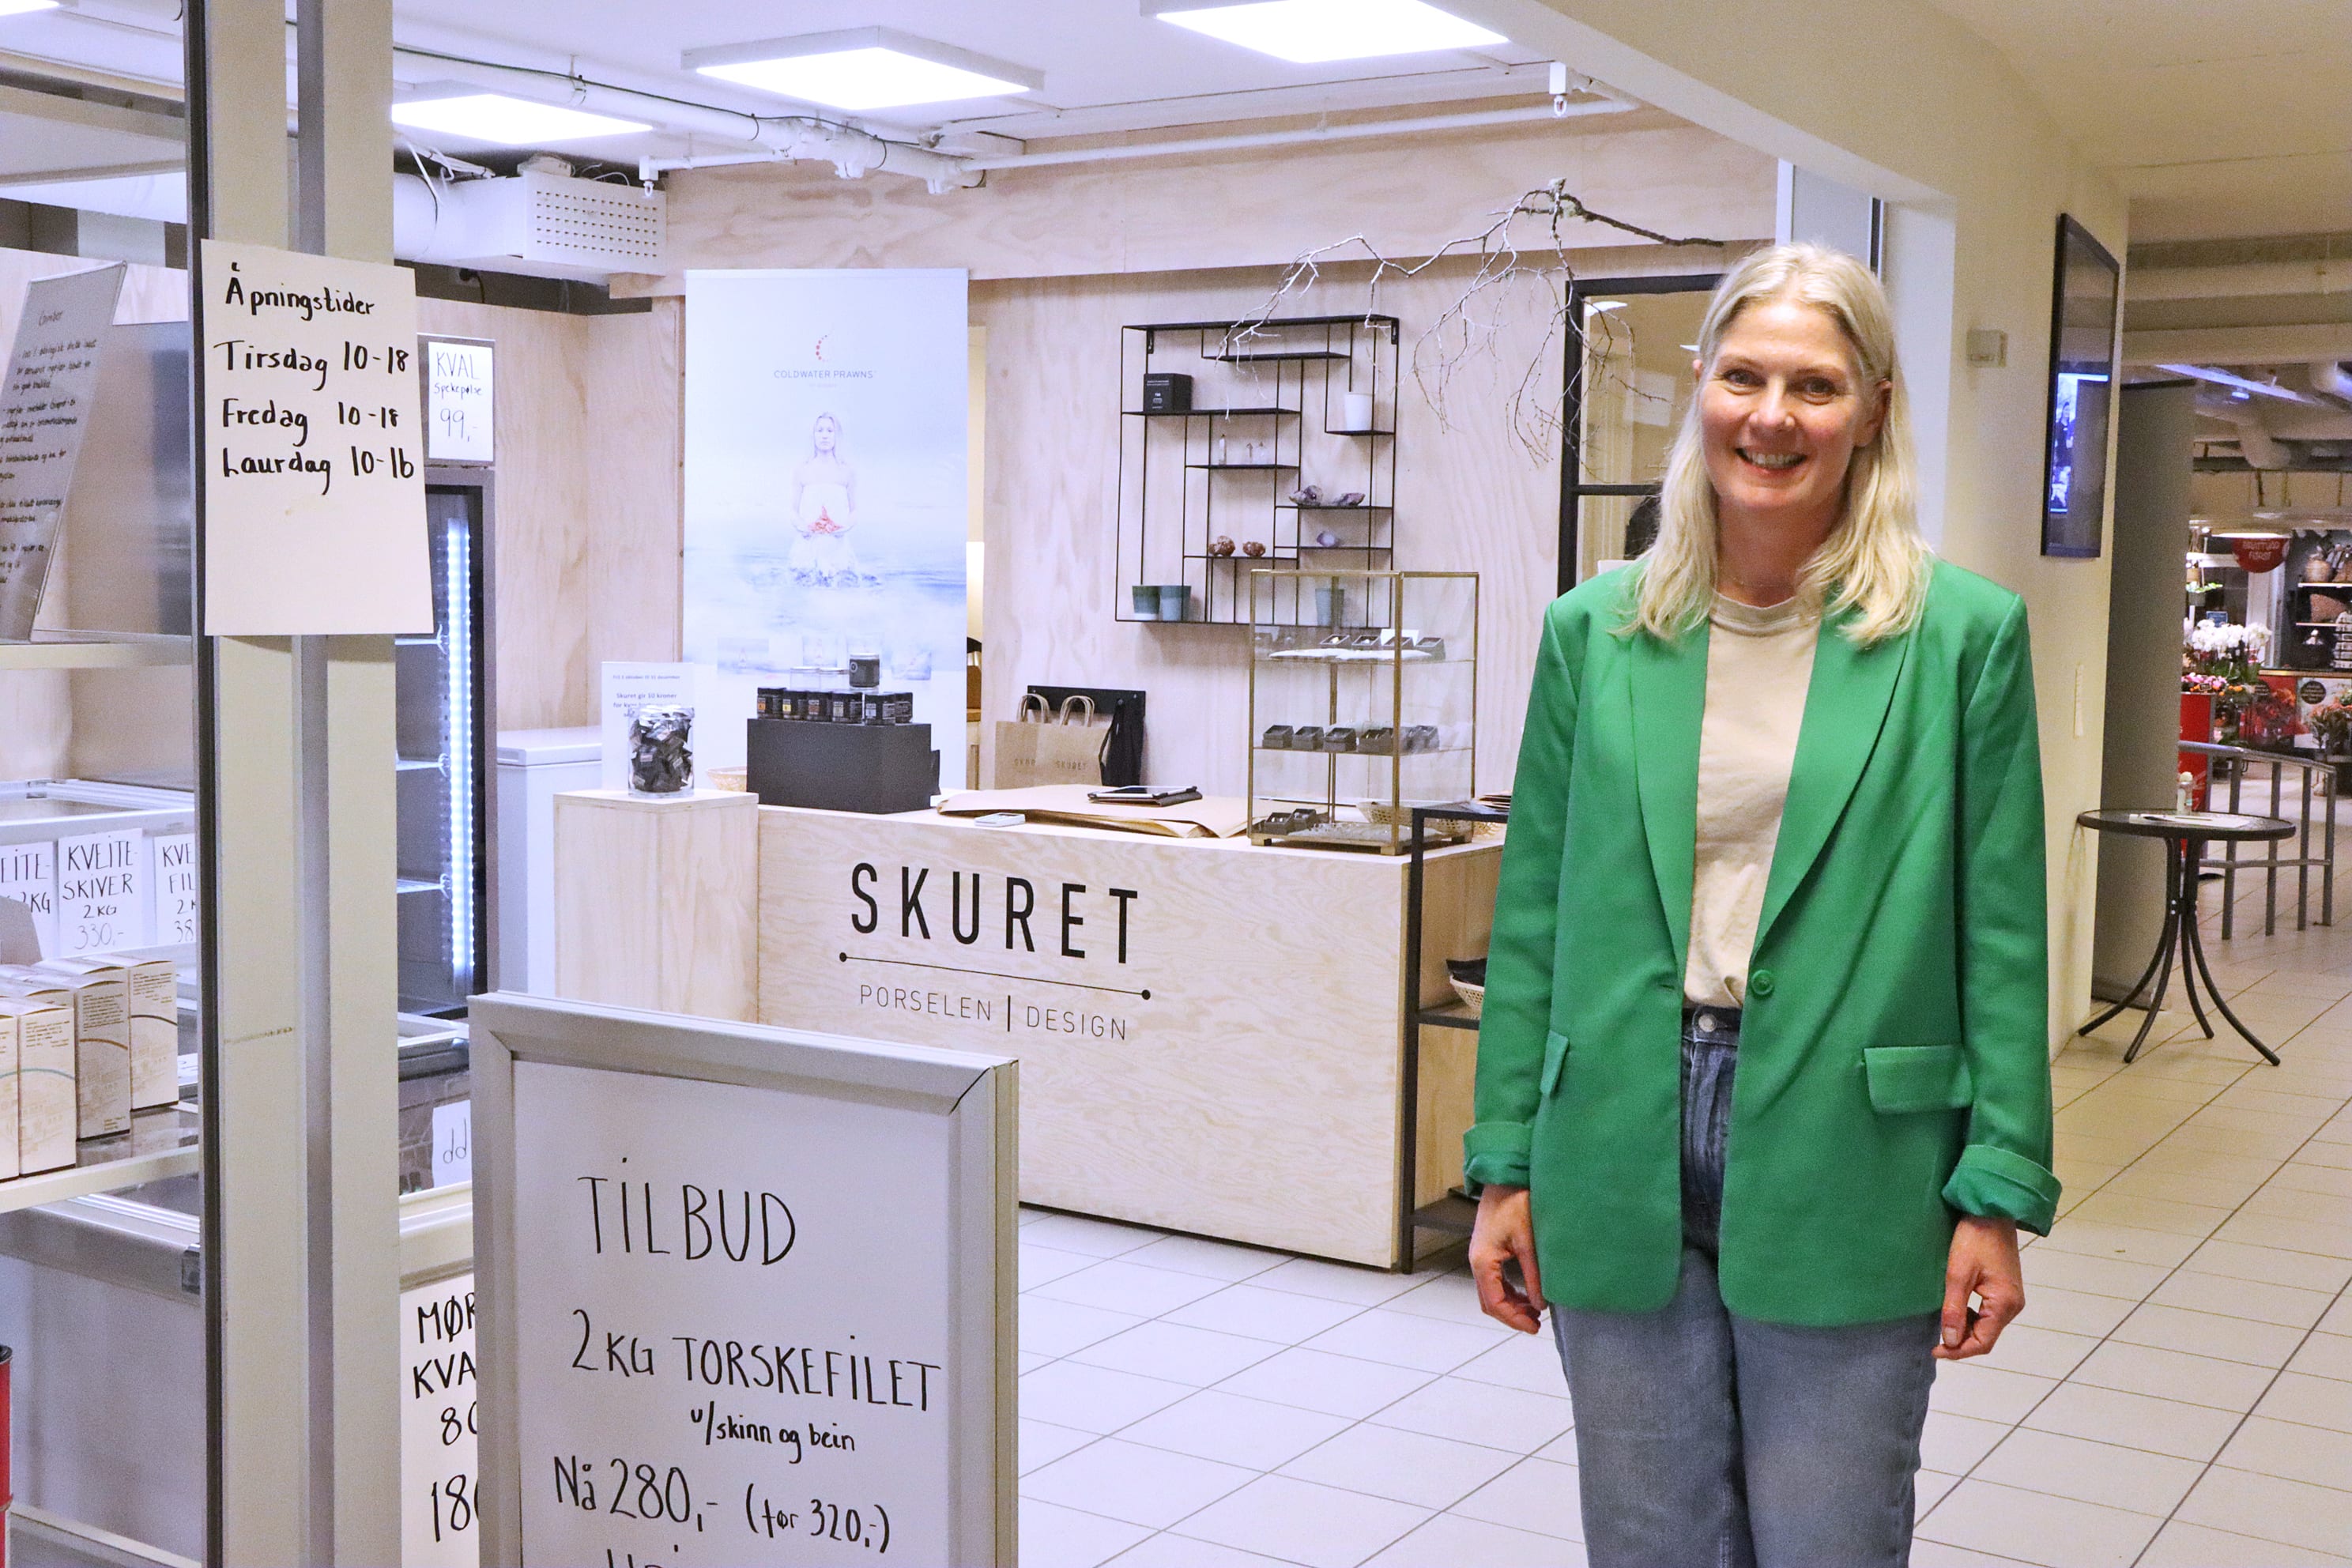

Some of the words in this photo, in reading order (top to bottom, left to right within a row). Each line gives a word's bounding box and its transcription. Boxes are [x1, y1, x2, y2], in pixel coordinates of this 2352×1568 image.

[226, 262, 375, 321] Åpningstider
[215, 340, 328, 391] Tirsdag
[344, 341, 409, 374] 10-18
[436, 352, 481, 379] KVAL
[773, 370, 831, 379] COLDWATER
[833, 370, 873, 379] PRAWNS
[223, 398, 308, 447] Fredag
[223, 447, 330, 496] Laurdag
[351, 446, 414, 479] 10-16
[1055, 760, 1087, 771] SKURET
[68, 835, 138, 871] KVEITE-
[62, 873, 134, 901] SKIVER
[851, 861, 1138, 965] SKURET
[860, 984, 991, 1021] PORSELEN
[1027, 1005, 1126, 1041] DESIGN
[577, 1156, 797, 1265] TILBUD
[572, 1308, 599, 1370] 2
[607, 1332, 655, 1377] KG
[672, 1334, 942, 1412] TORSKEFILET
[778, 1427, 803, 1464] og
[808, 1422, 856, 1452] bein
[431, 1473, 479, 1543] 18
[553, 1455, 597, 1510] Nå
[610, 1457, 718, 1532] 280,-
